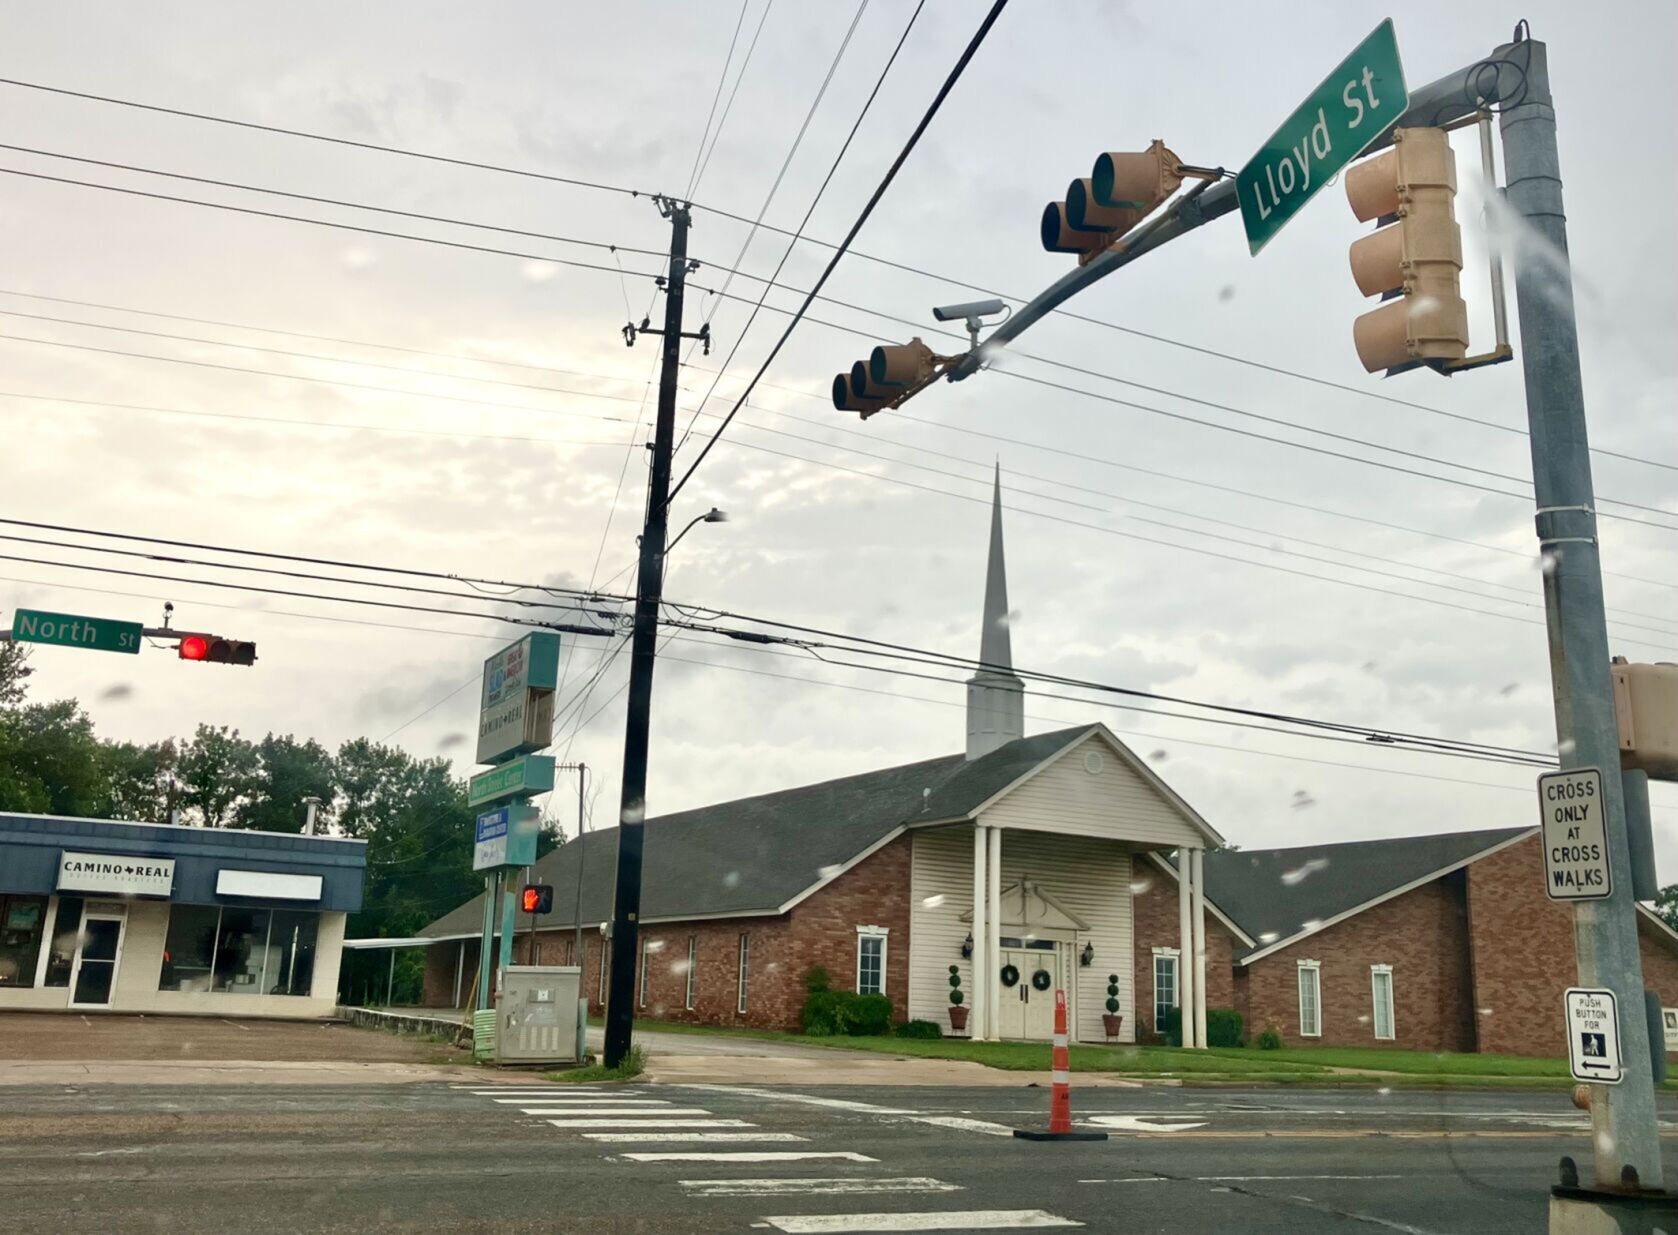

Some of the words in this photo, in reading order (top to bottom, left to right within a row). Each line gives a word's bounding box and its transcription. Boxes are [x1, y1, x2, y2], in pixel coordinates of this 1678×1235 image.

[1253, 107, 1332, 220] Lloyd
[1343, 66, 1380, 129] St
[19, 615, 97, 643] North
[118, 632, 135, 648] St
[1547, 781, 1594, 801] CROSS
[1555, 804, 1589, 823] ONLY
[1567, 827, 1580, 840] AT
[1552, 845, 1600, 863] CROSS
[64, 861, 122, 875] CAMINO
[135, 866, 170, 878] REAL
[1553, 869, 1603, 887] WALKS
[1579, 998, 1601, 1008] PUSH
[1575, 1008, 1607, 1019] BUTTON
[1584, 1021, 1600, 1030] FOR
